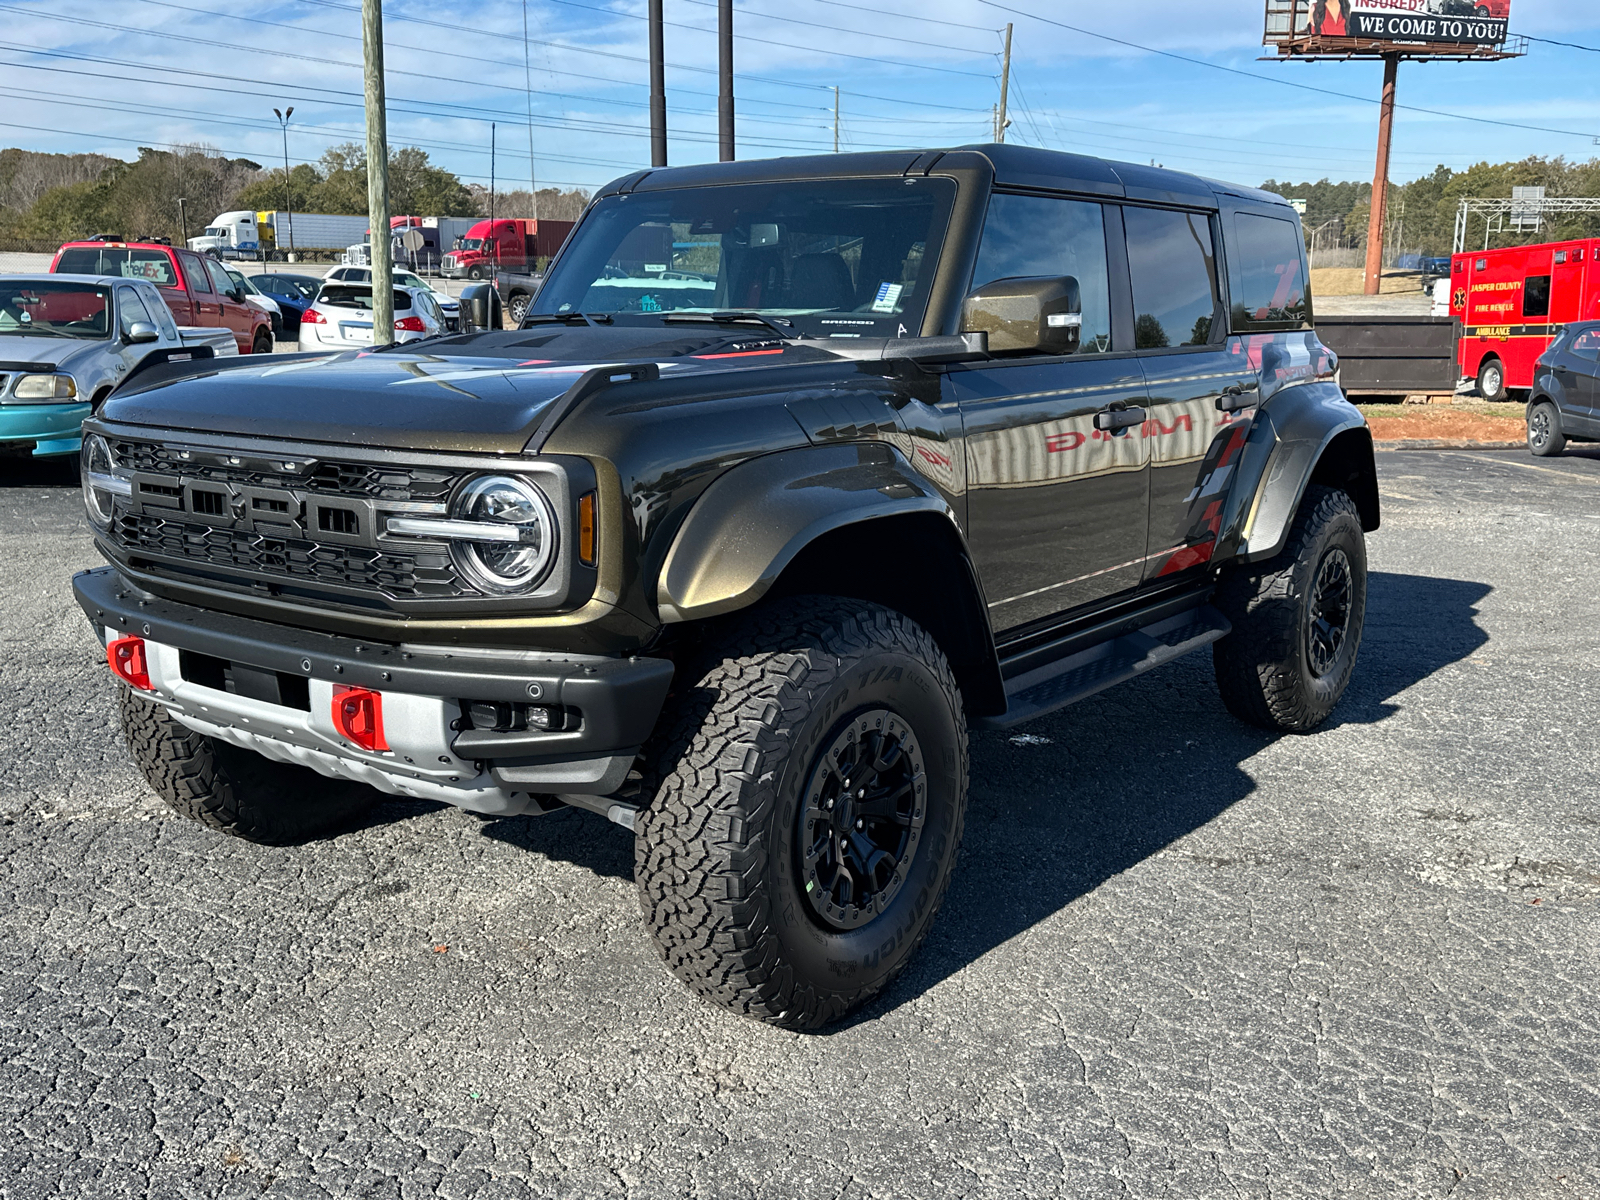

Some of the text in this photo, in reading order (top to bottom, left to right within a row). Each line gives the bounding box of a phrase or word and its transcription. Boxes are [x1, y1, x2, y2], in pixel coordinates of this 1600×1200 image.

[1355, 0, 1425, 11] INSURED?
[1359, 16, 1504, 39] WE COME TO YOU!
[1470, 281, 1522, 293] JASPER COUNTY
[1475, 303, 1514, 312] FIRE RESCUE
[1475, 327, 1510, 336] AMBULANCE
[1275, 365, 1314, 380] RAPTOR
[131, 469, 378, 547] FORD
[858, 665, 903, 691] T/A
